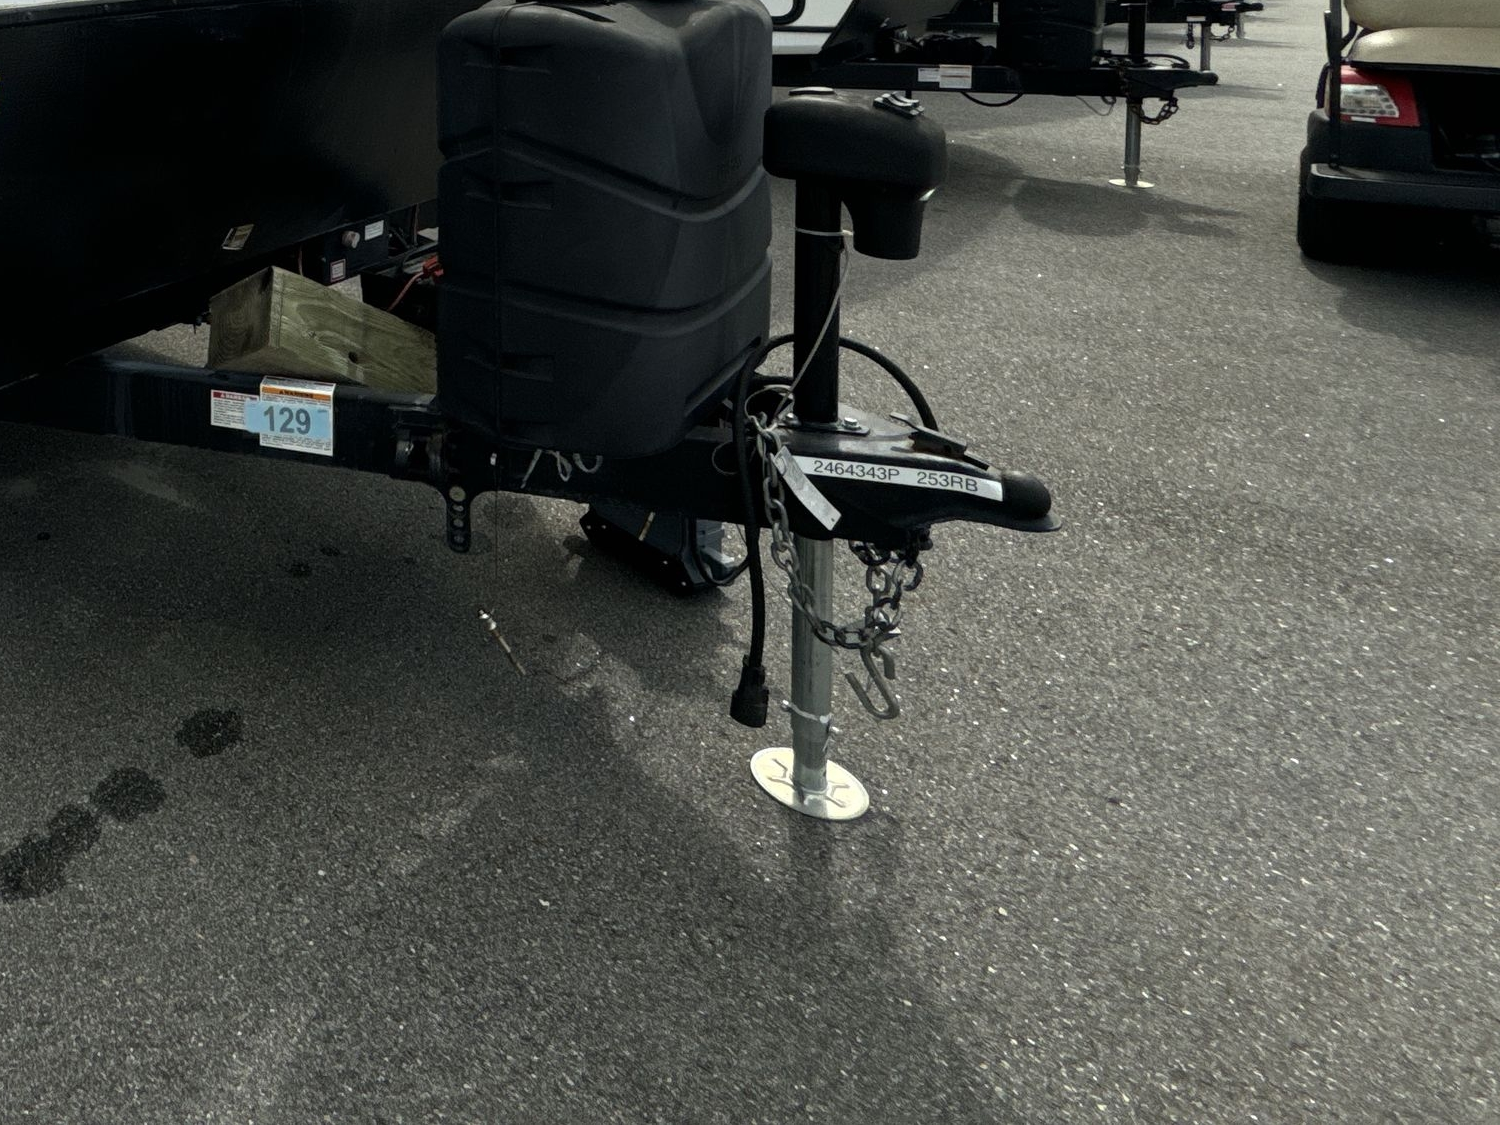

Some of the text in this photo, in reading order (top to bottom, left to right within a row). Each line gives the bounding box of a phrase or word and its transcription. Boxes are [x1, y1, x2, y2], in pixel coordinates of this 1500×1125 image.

[263, 405, 312, 435] 129
[813, 459, 979, 493] 2464343P 253RB
